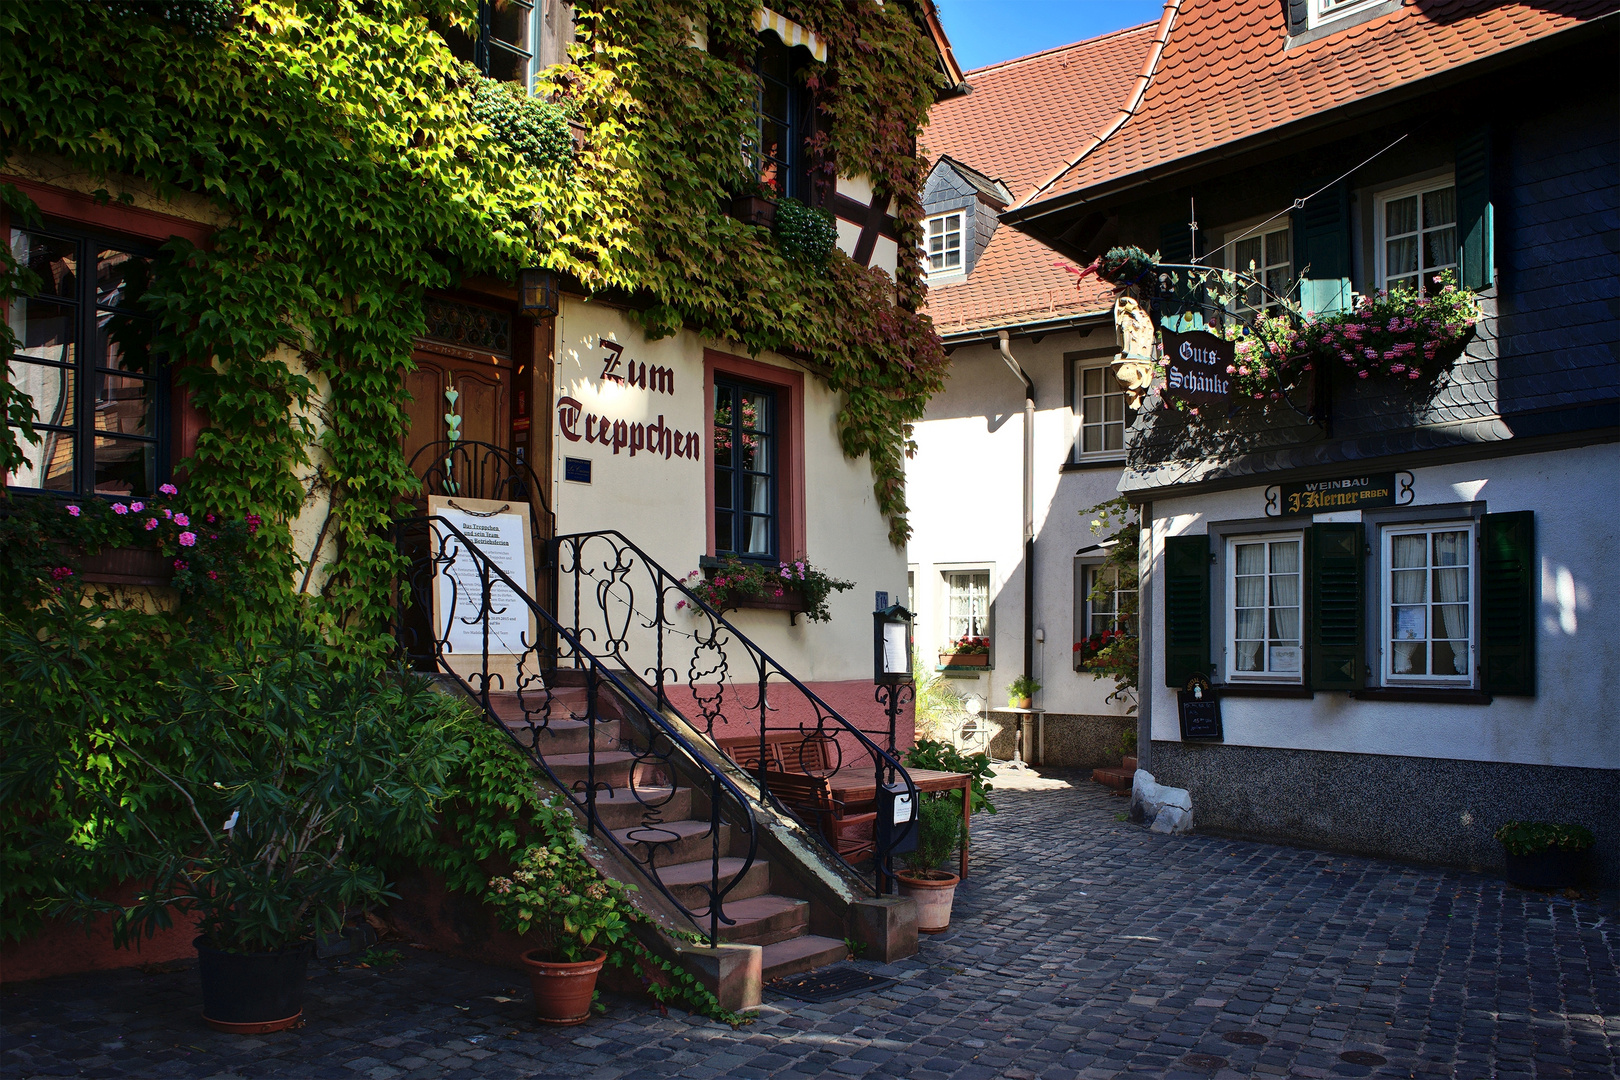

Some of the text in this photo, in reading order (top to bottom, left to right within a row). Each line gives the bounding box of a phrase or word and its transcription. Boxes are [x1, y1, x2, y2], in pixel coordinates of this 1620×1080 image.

[600, 337, 674, 396] Zum
[1169, 365, 1229, 394] Schänke
[557, 396, 700, 462] Treppchen
[1305, 478, 1369, 491] WEINBAU
[1360, 489, 1388, 499] ERBEN
[473, 523, 500, 531] Treppchen
